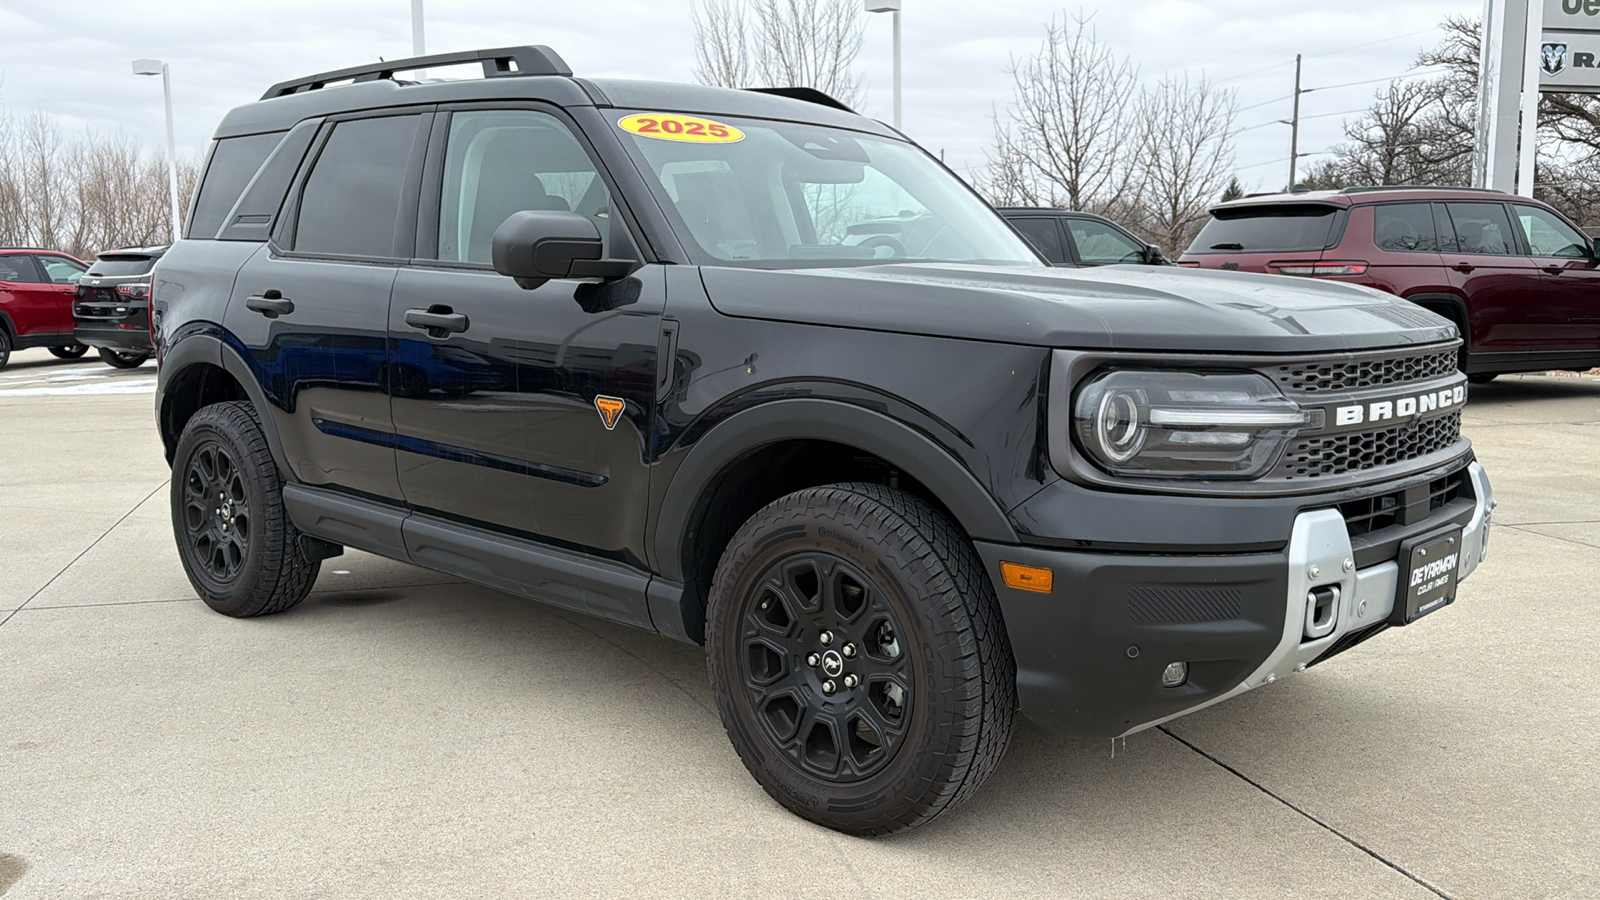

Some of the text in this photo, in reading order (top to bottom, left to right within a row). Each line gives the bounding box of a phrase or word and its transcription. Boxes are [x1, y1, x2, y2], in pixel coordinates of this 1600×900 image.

[637, 118, 729, 138] 2025
[1336, 385, 1464, 426] BRONCO
[818, 526, 860, 550] Continental
[1410, 552, 1458, 587] DEYARMAN
